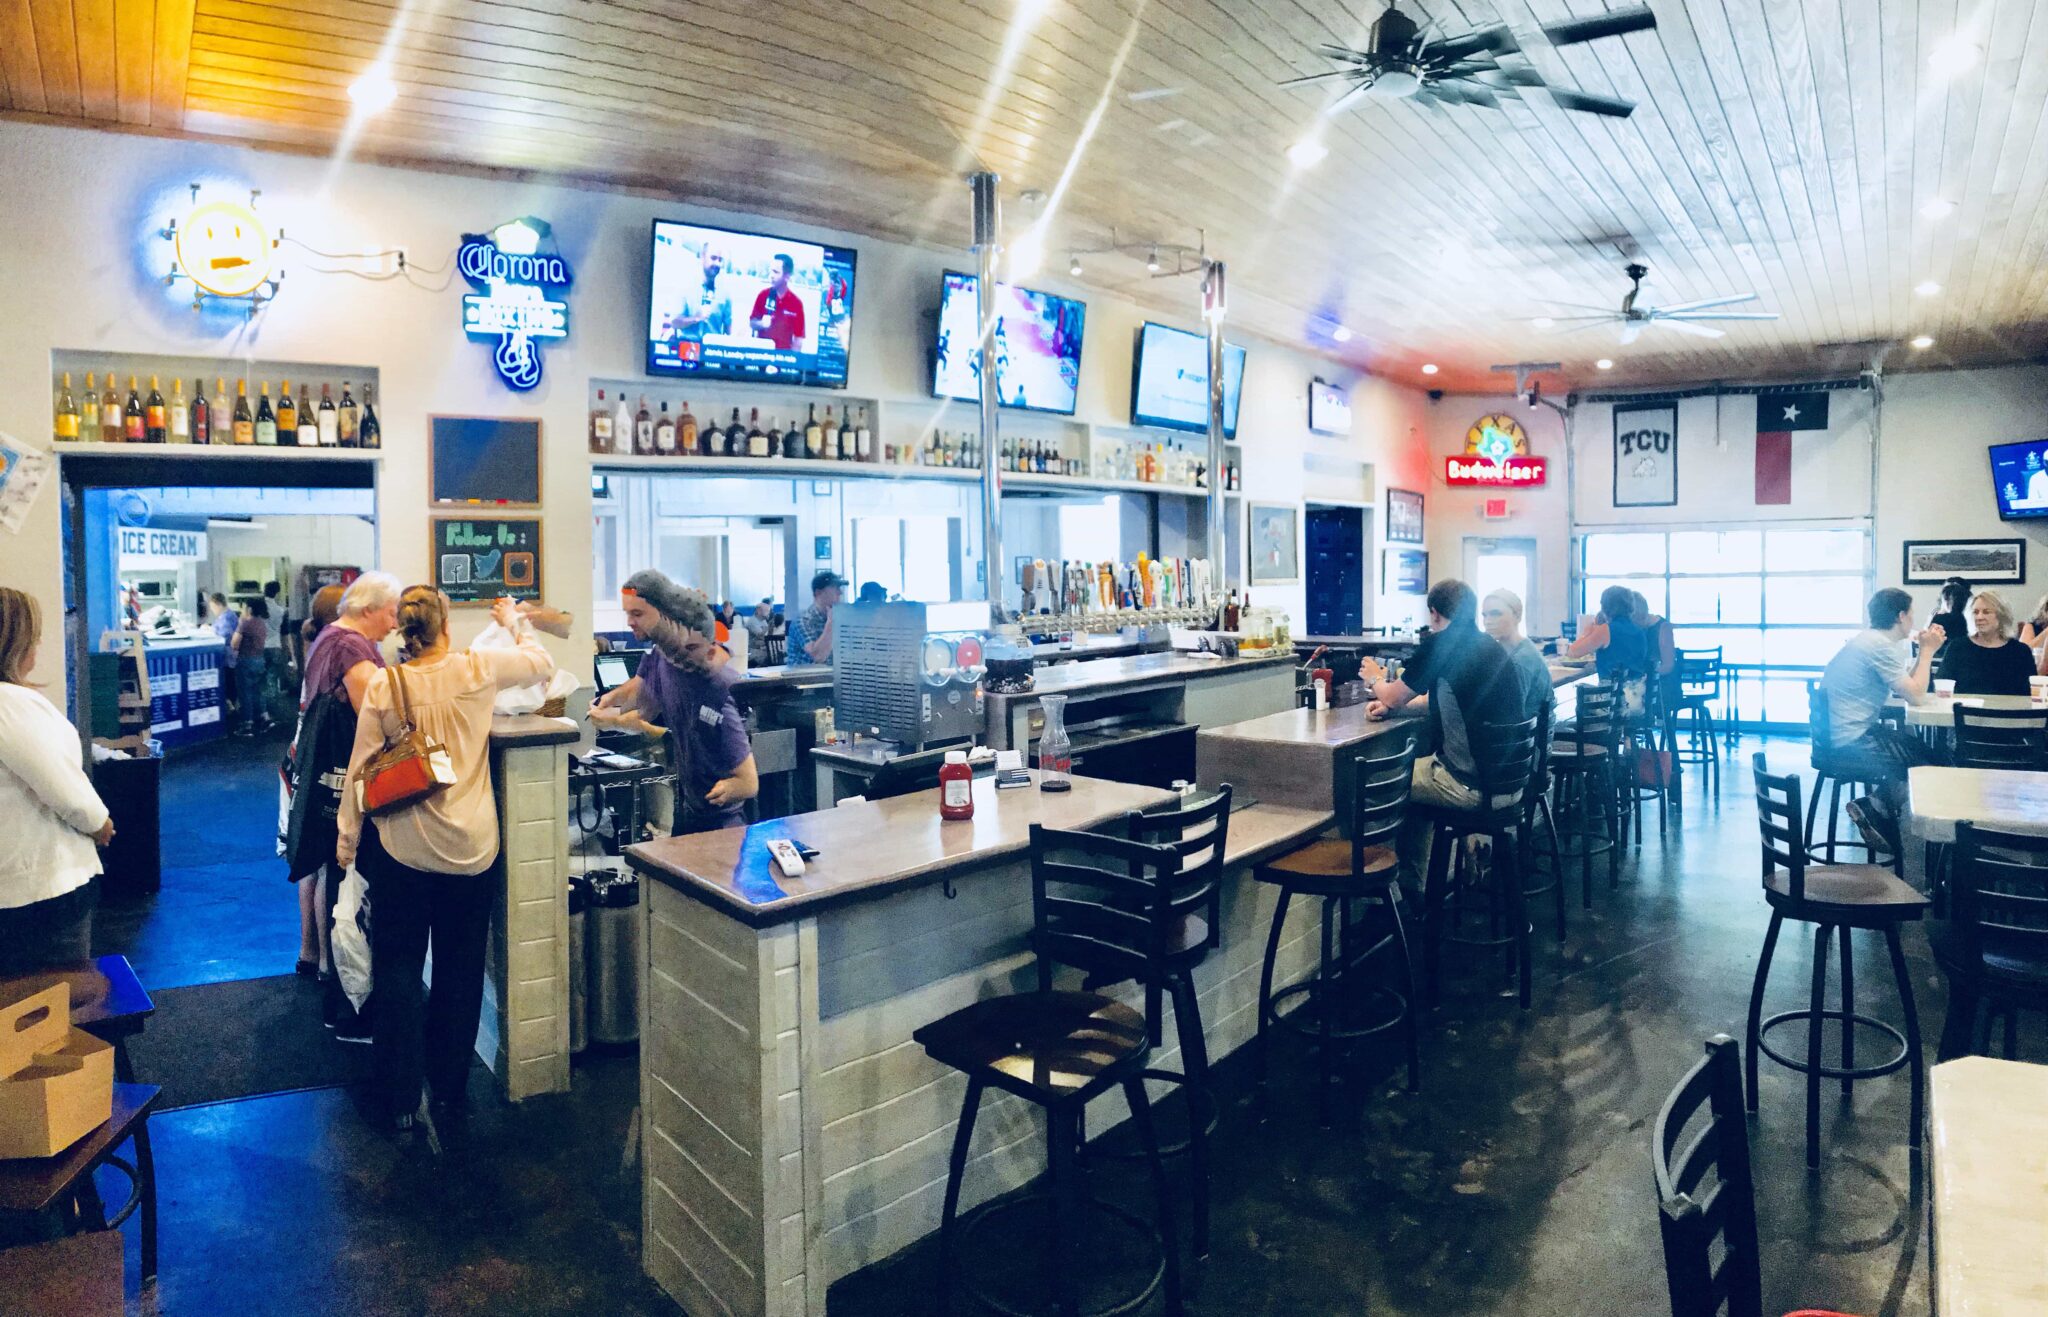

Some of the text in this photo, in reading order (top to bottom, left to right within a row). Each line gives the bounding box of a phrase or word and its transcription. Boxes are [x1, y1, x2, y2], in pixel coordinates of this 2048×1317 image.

[460, 243, 566, 284] Corona
[1466, 415, 1527, 451] TEXAS
[1620, 429, 1671, 456] TCU
[1448, 460, 1542, 480] Budweiser
[122, 531, 197, 556] ICE CREAM
